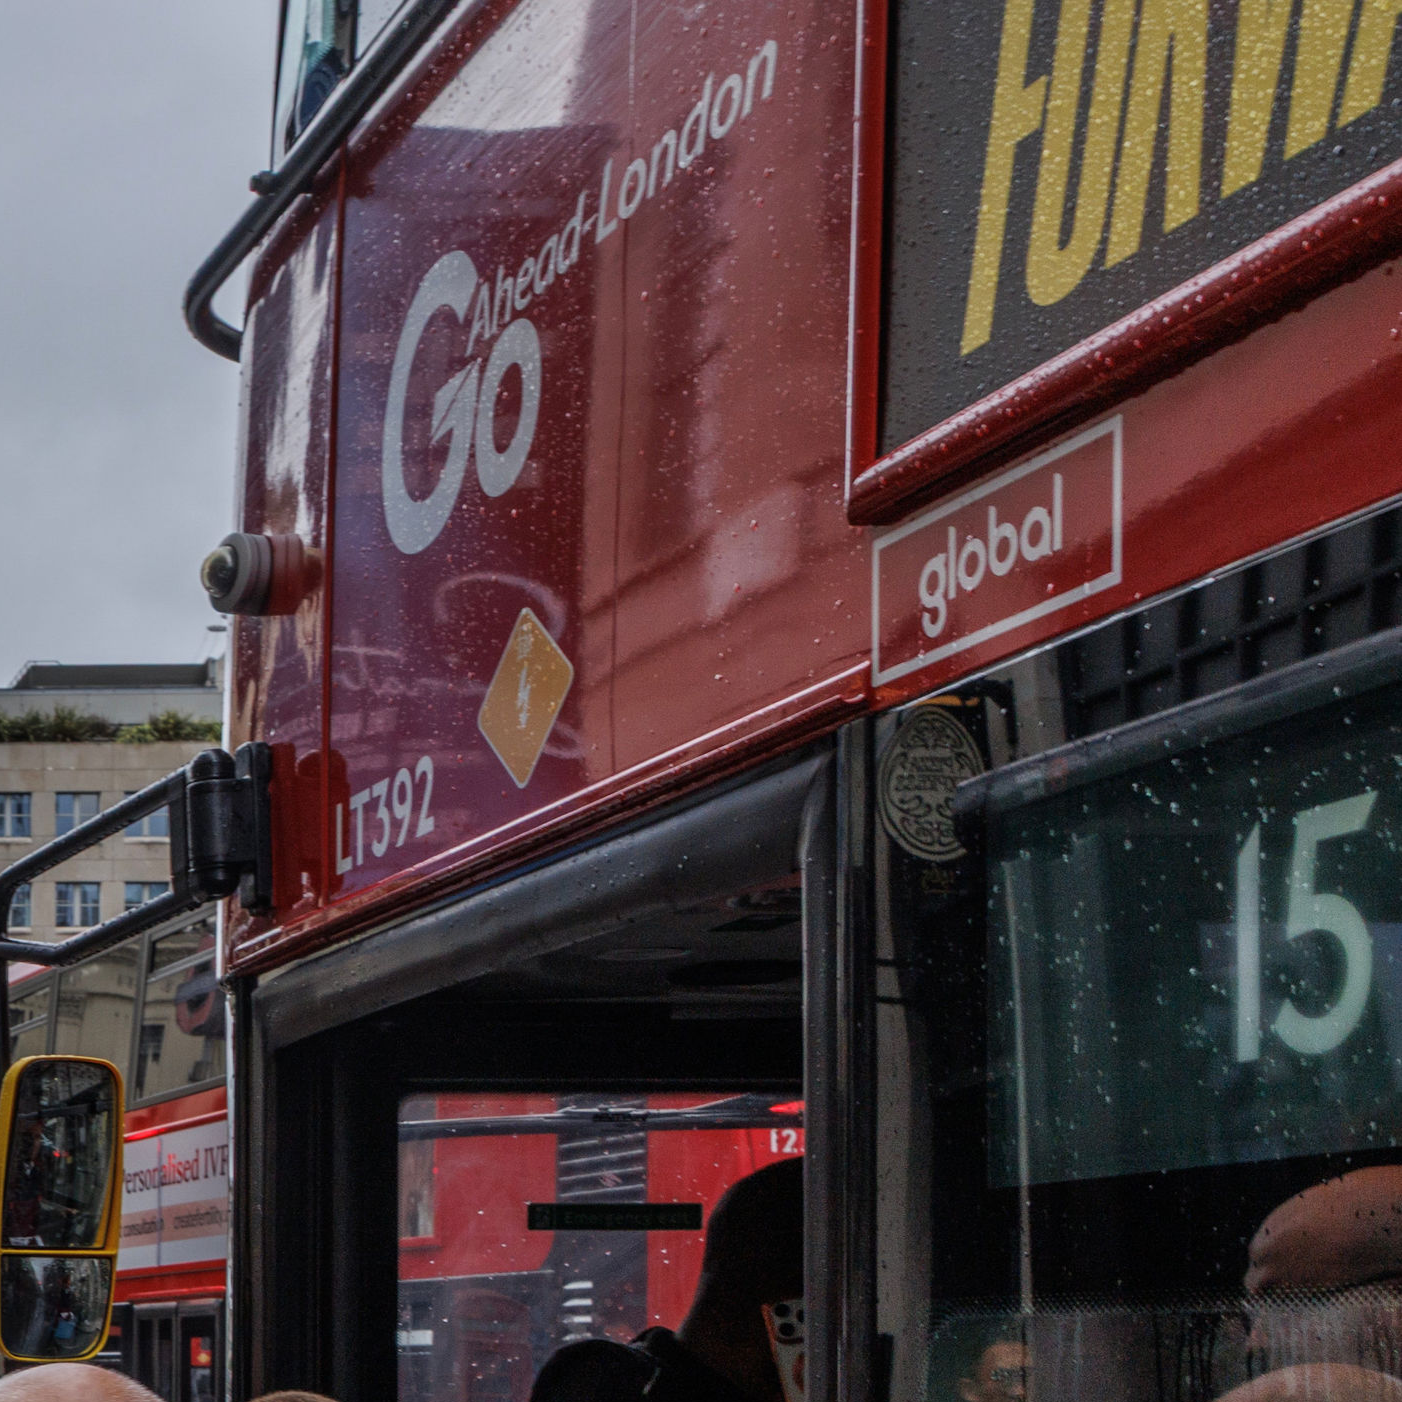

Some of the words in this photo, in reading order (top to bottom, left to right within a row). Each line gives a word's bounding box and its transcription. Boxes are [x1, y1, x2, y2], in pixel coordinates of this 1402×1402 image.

[465, 39, 778, 357] Ahead-London
[382, 250, 543, 555] Go
[916, 472, 1064, 640] global
[336, 755, 435, 876] LT392
[1236, 789, 1379, 1064] 15
